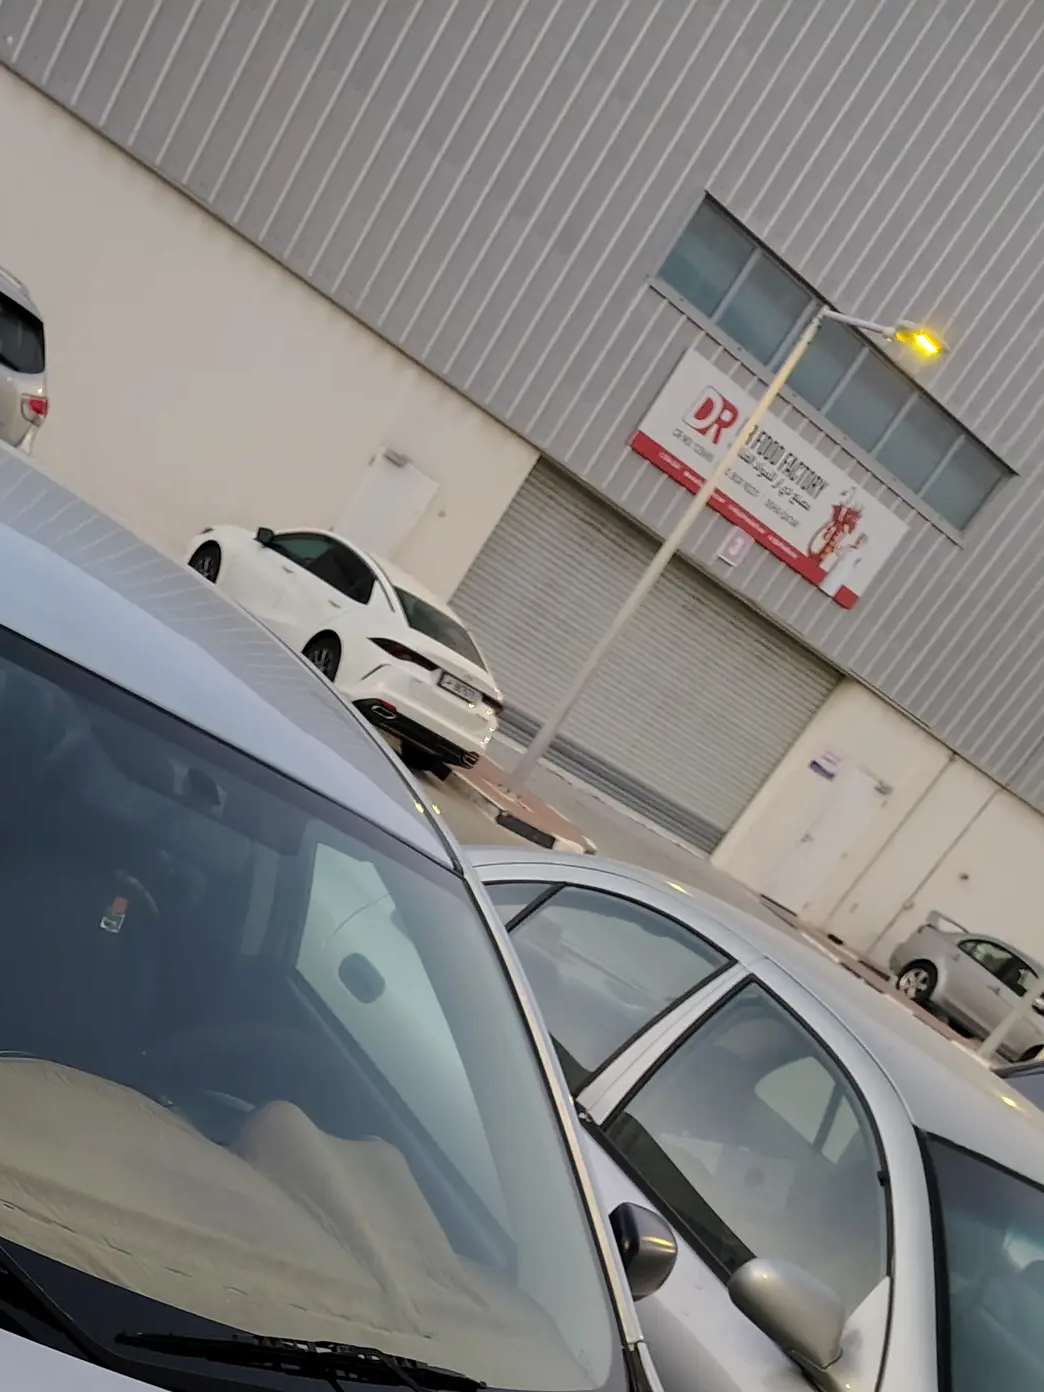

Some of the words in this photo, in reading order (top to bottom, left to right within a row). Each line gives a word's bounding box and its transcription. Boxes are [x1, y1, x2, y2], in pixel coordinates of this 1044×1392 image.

[682, 385, 739, 444] DR
[750, 430, 786, 465] FOOD
[779, 451, 829, 499] FACTORY
